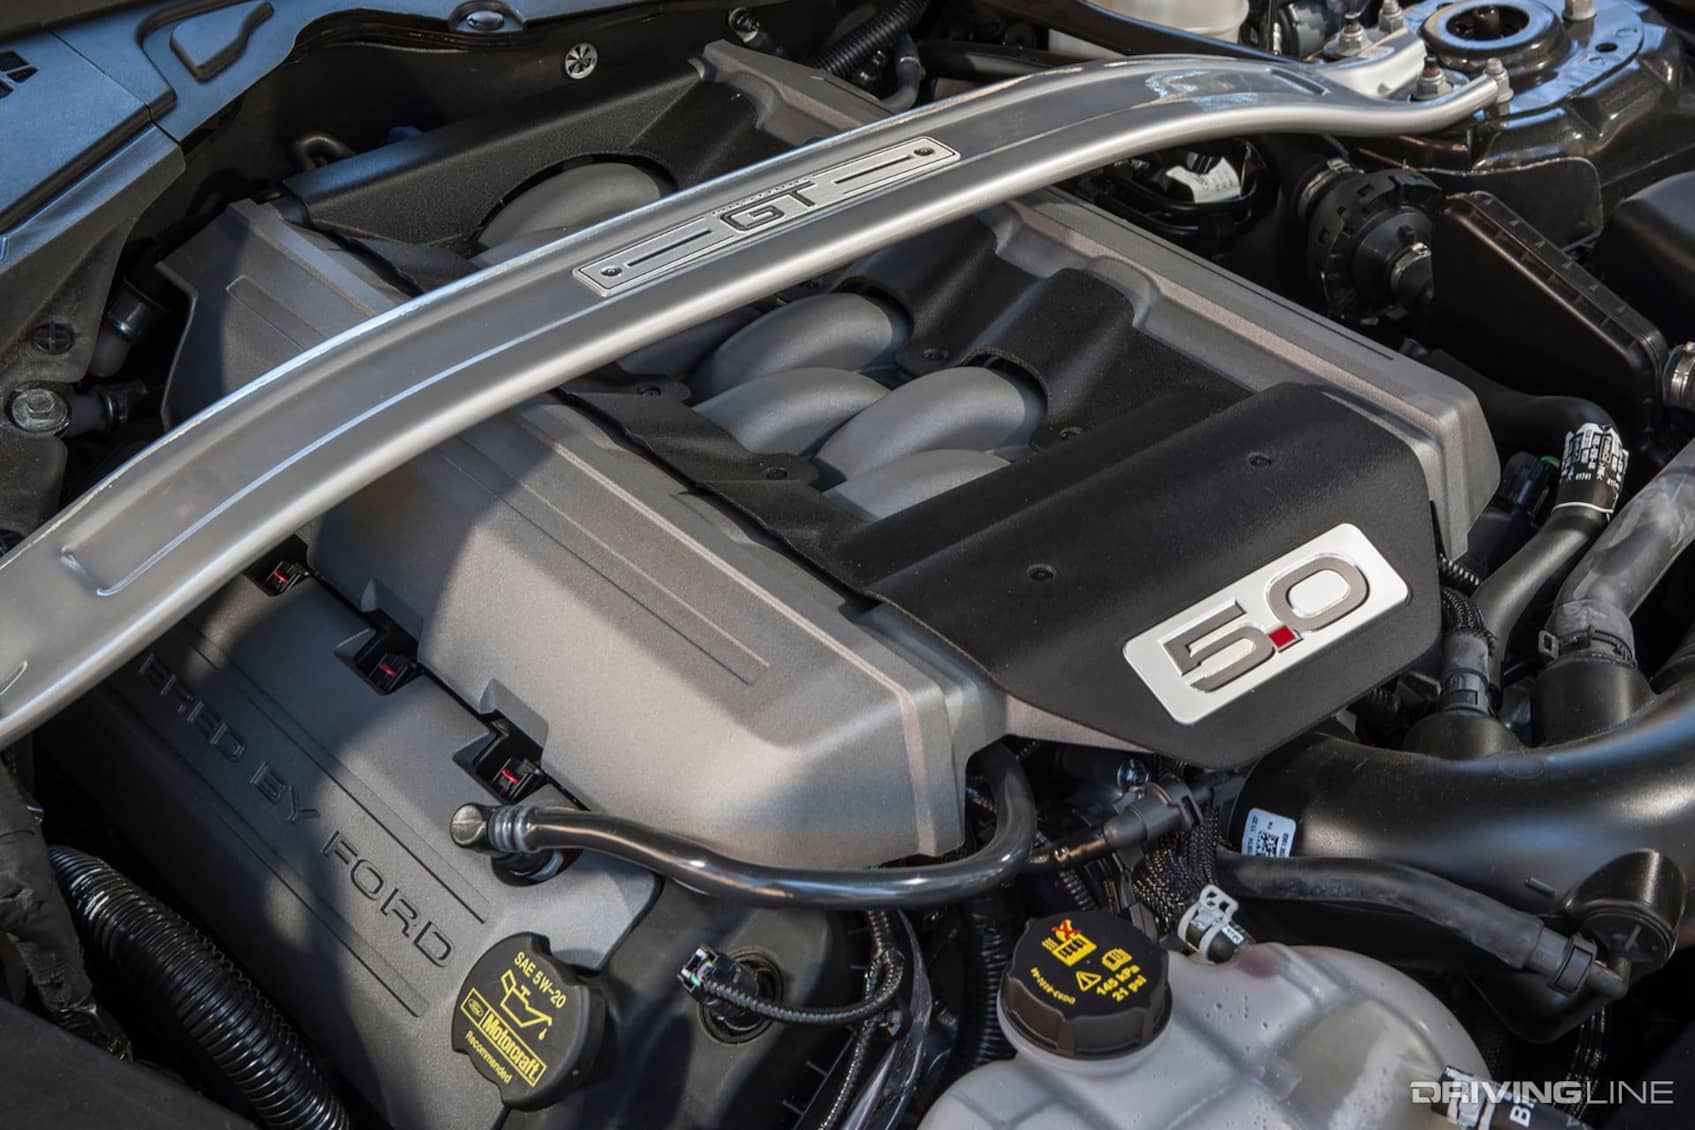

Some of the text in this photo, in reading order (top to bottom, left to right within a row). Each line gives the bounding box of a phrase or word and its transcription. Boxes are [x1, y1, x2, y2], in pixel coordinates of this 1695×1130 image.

[719, 180, 816, 232] GT
[1158, 551, 1370, 693] 5.0
[250, 762, 320, 824] BY
[320, 830, 456, 968] FORD
[514, 951, 567, 1009] SAE 5W-20
[1112, 987, 1129, 1002] 21
[465, 1030, 513, 1085] Recommended
[482, 1013, 542, 1081] Motorcraft
